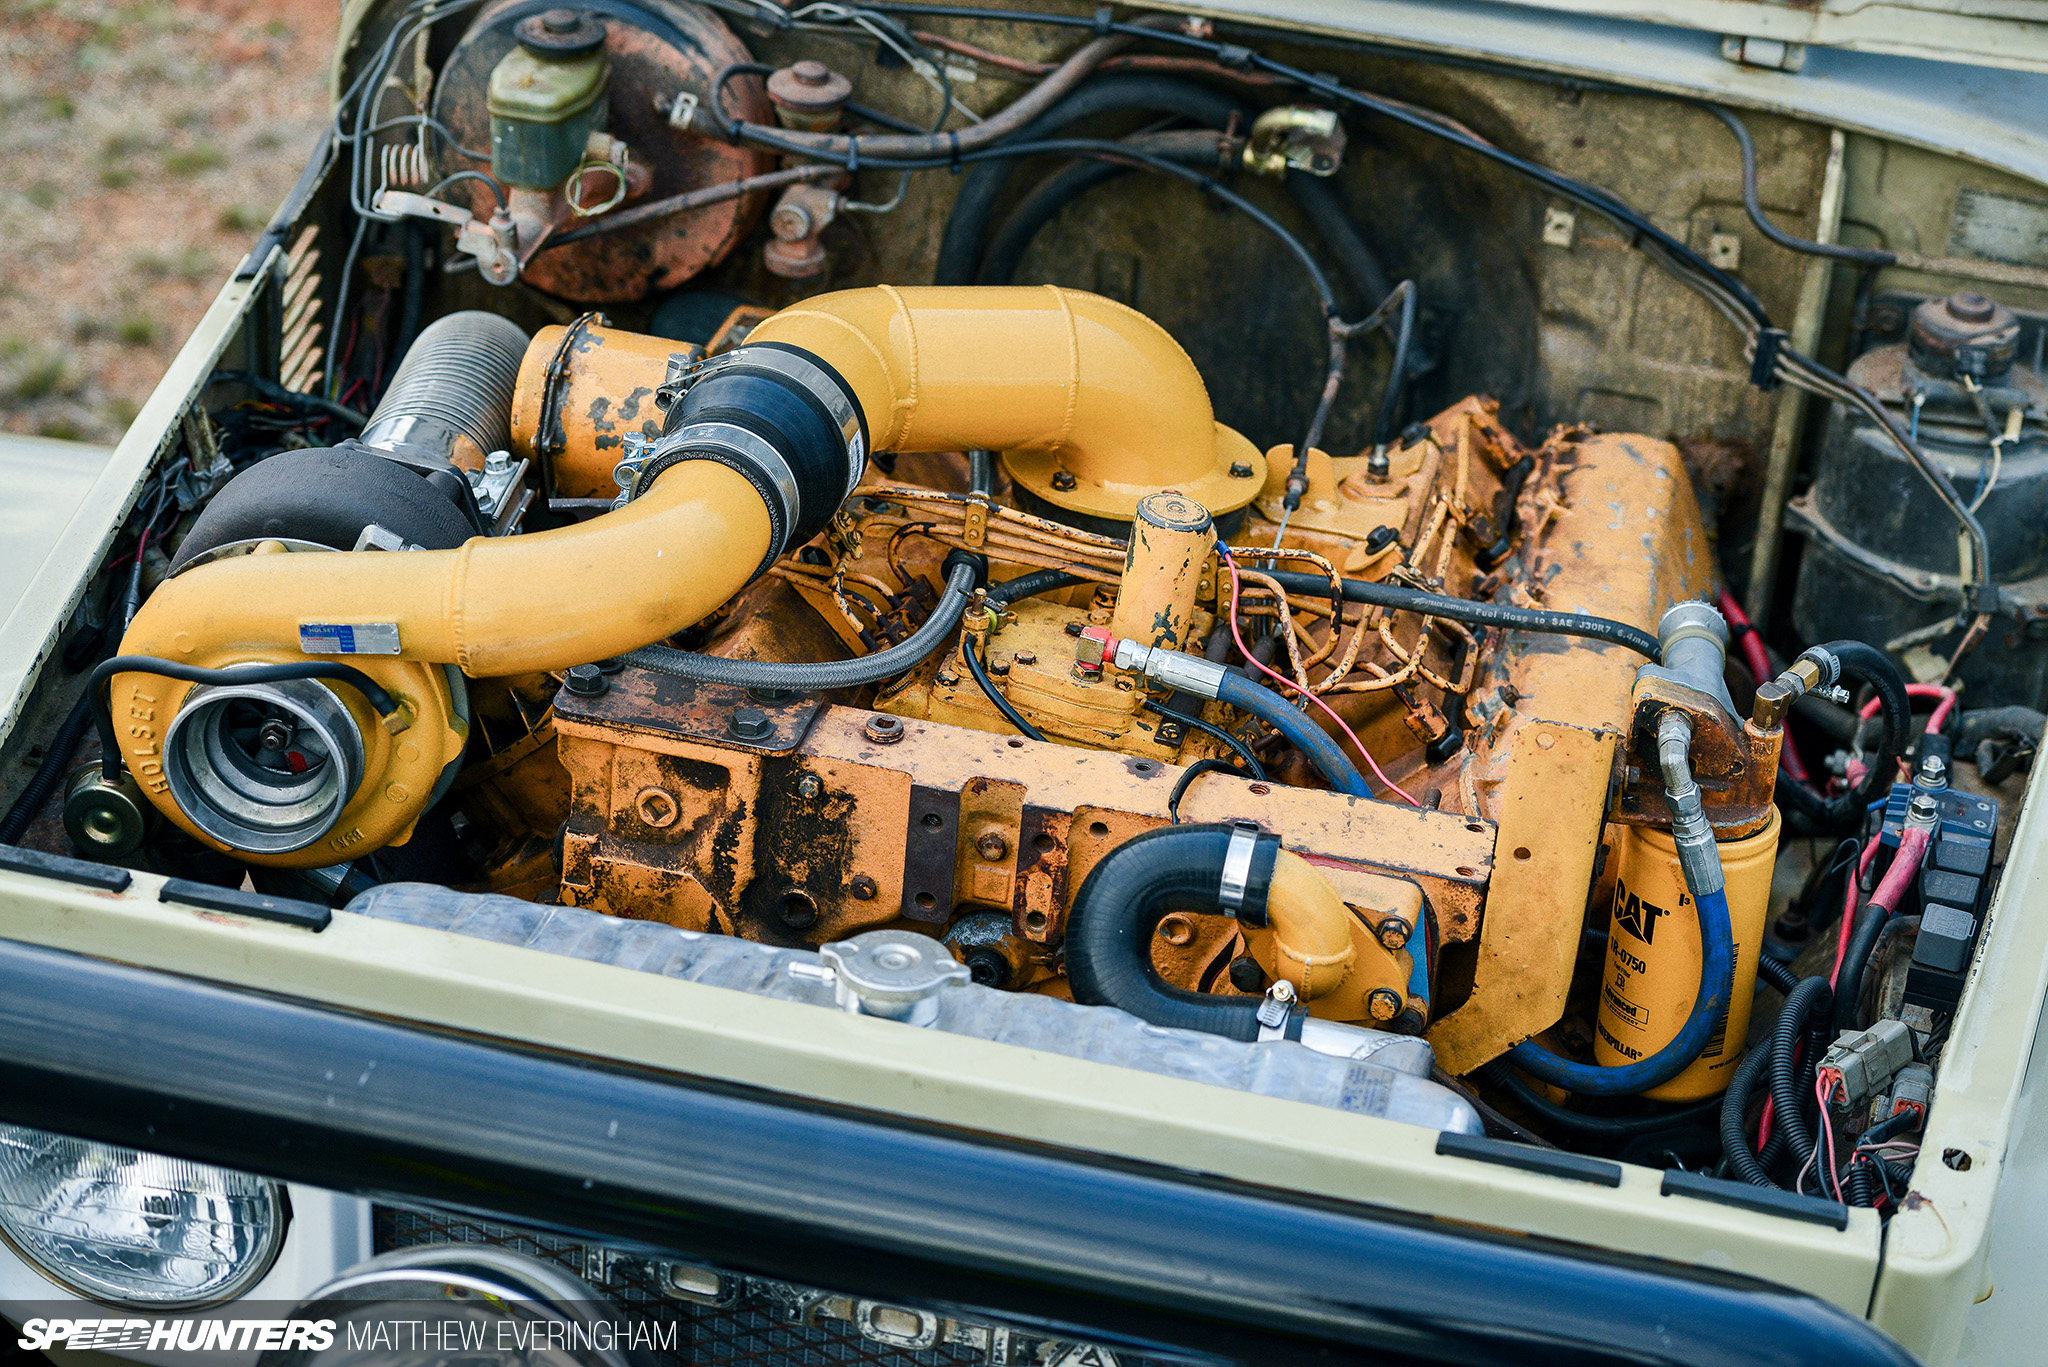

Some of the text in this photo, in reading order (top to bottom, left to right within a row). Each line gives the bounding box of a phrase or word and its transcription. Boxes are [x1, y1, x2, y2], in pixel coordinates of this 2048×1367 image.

[1475, 608, 1498, 618] Fuel
[1503, 612, 1528, 622] Hose
[1535, 613, 1546, 624] to
[1552, 616, 1573, 627] SAE
[1578, 620, 1612, 634] J30R7
[1617, 628, 1649, 649] 6.4mm
[130, 686, 169, 794] HOLSET
[1613, 877, 1663, 946] CAT
